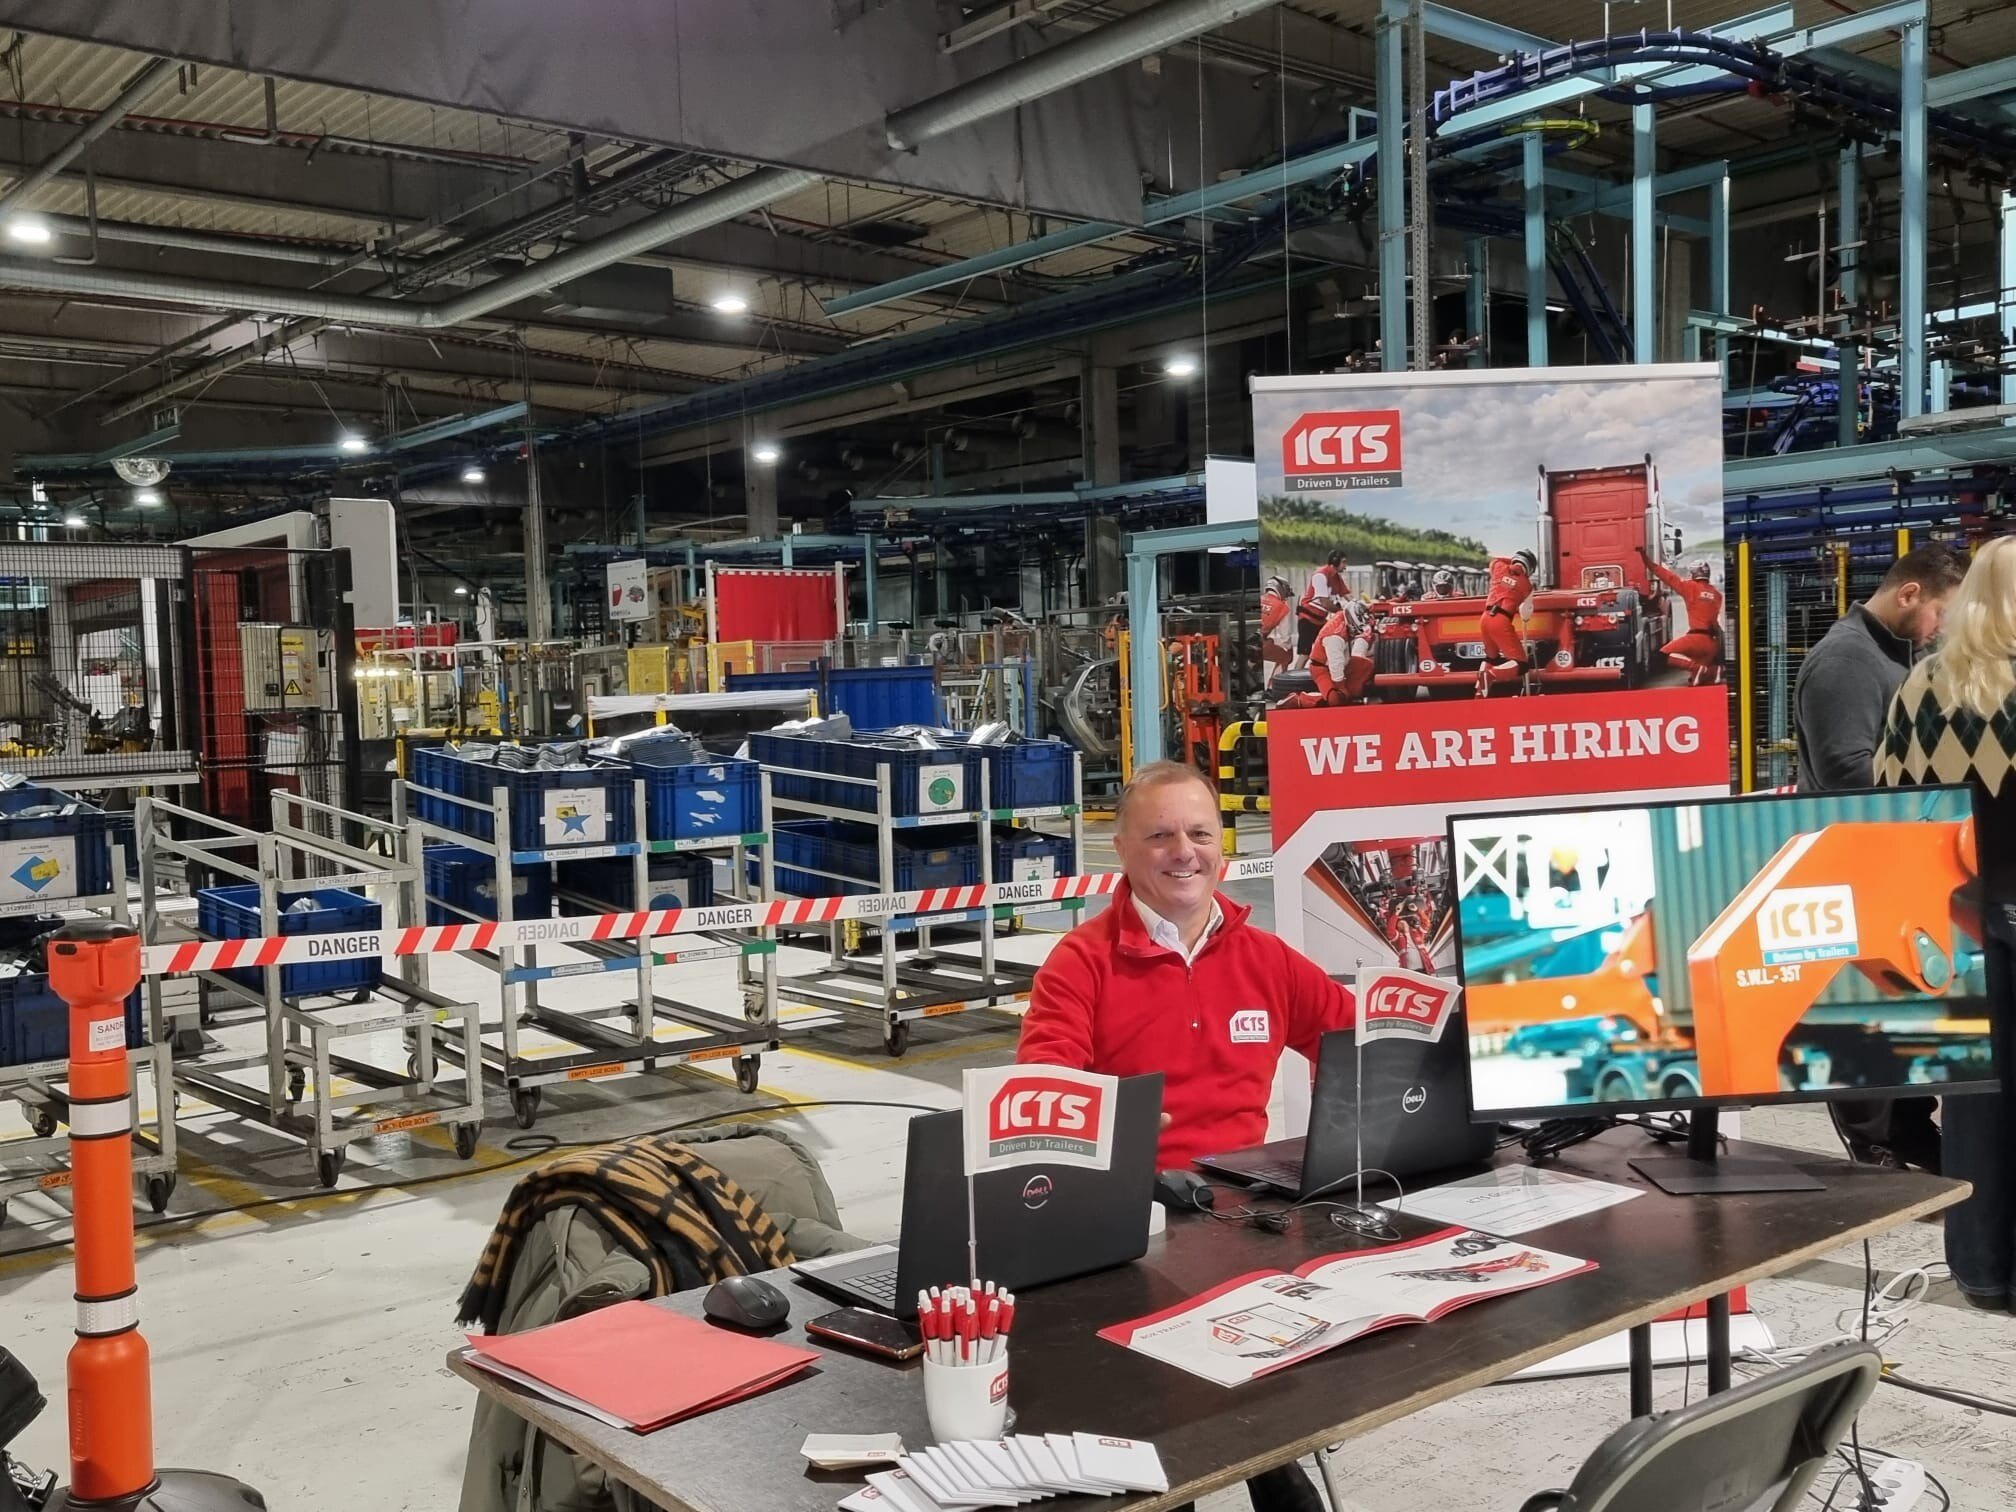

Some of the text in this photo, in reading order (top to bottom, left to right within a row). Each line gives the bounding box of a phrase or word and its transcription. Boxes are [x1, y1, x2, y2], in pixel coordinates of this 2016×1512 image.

[1294, 424, 1392, 466] ICTS
[1296, 474, 1391, 490] Driven by Trailers
[1392, 605, 1413, 615] ICTS
[1577, 597, 1597, 607] ICTS
[1299, 715, 1700, 776] WE ARE HIRING
[998, 884, 1043, 900] DANGER
[697, 908, 753, 927] DANGER
[1769, 899, 1844, 941] ICTS
[308, 935, 381, 957] DANGER
[1369, 986, 1440, 1019] ICTS
[1234, 1016, 1265, 1032] ICTS
[1405, 1094, 1423, 1104] DELL
[999, 1090, 1092, 1131] ICTS
[999, 1138, 1084, 1153] Driven by Trailers
